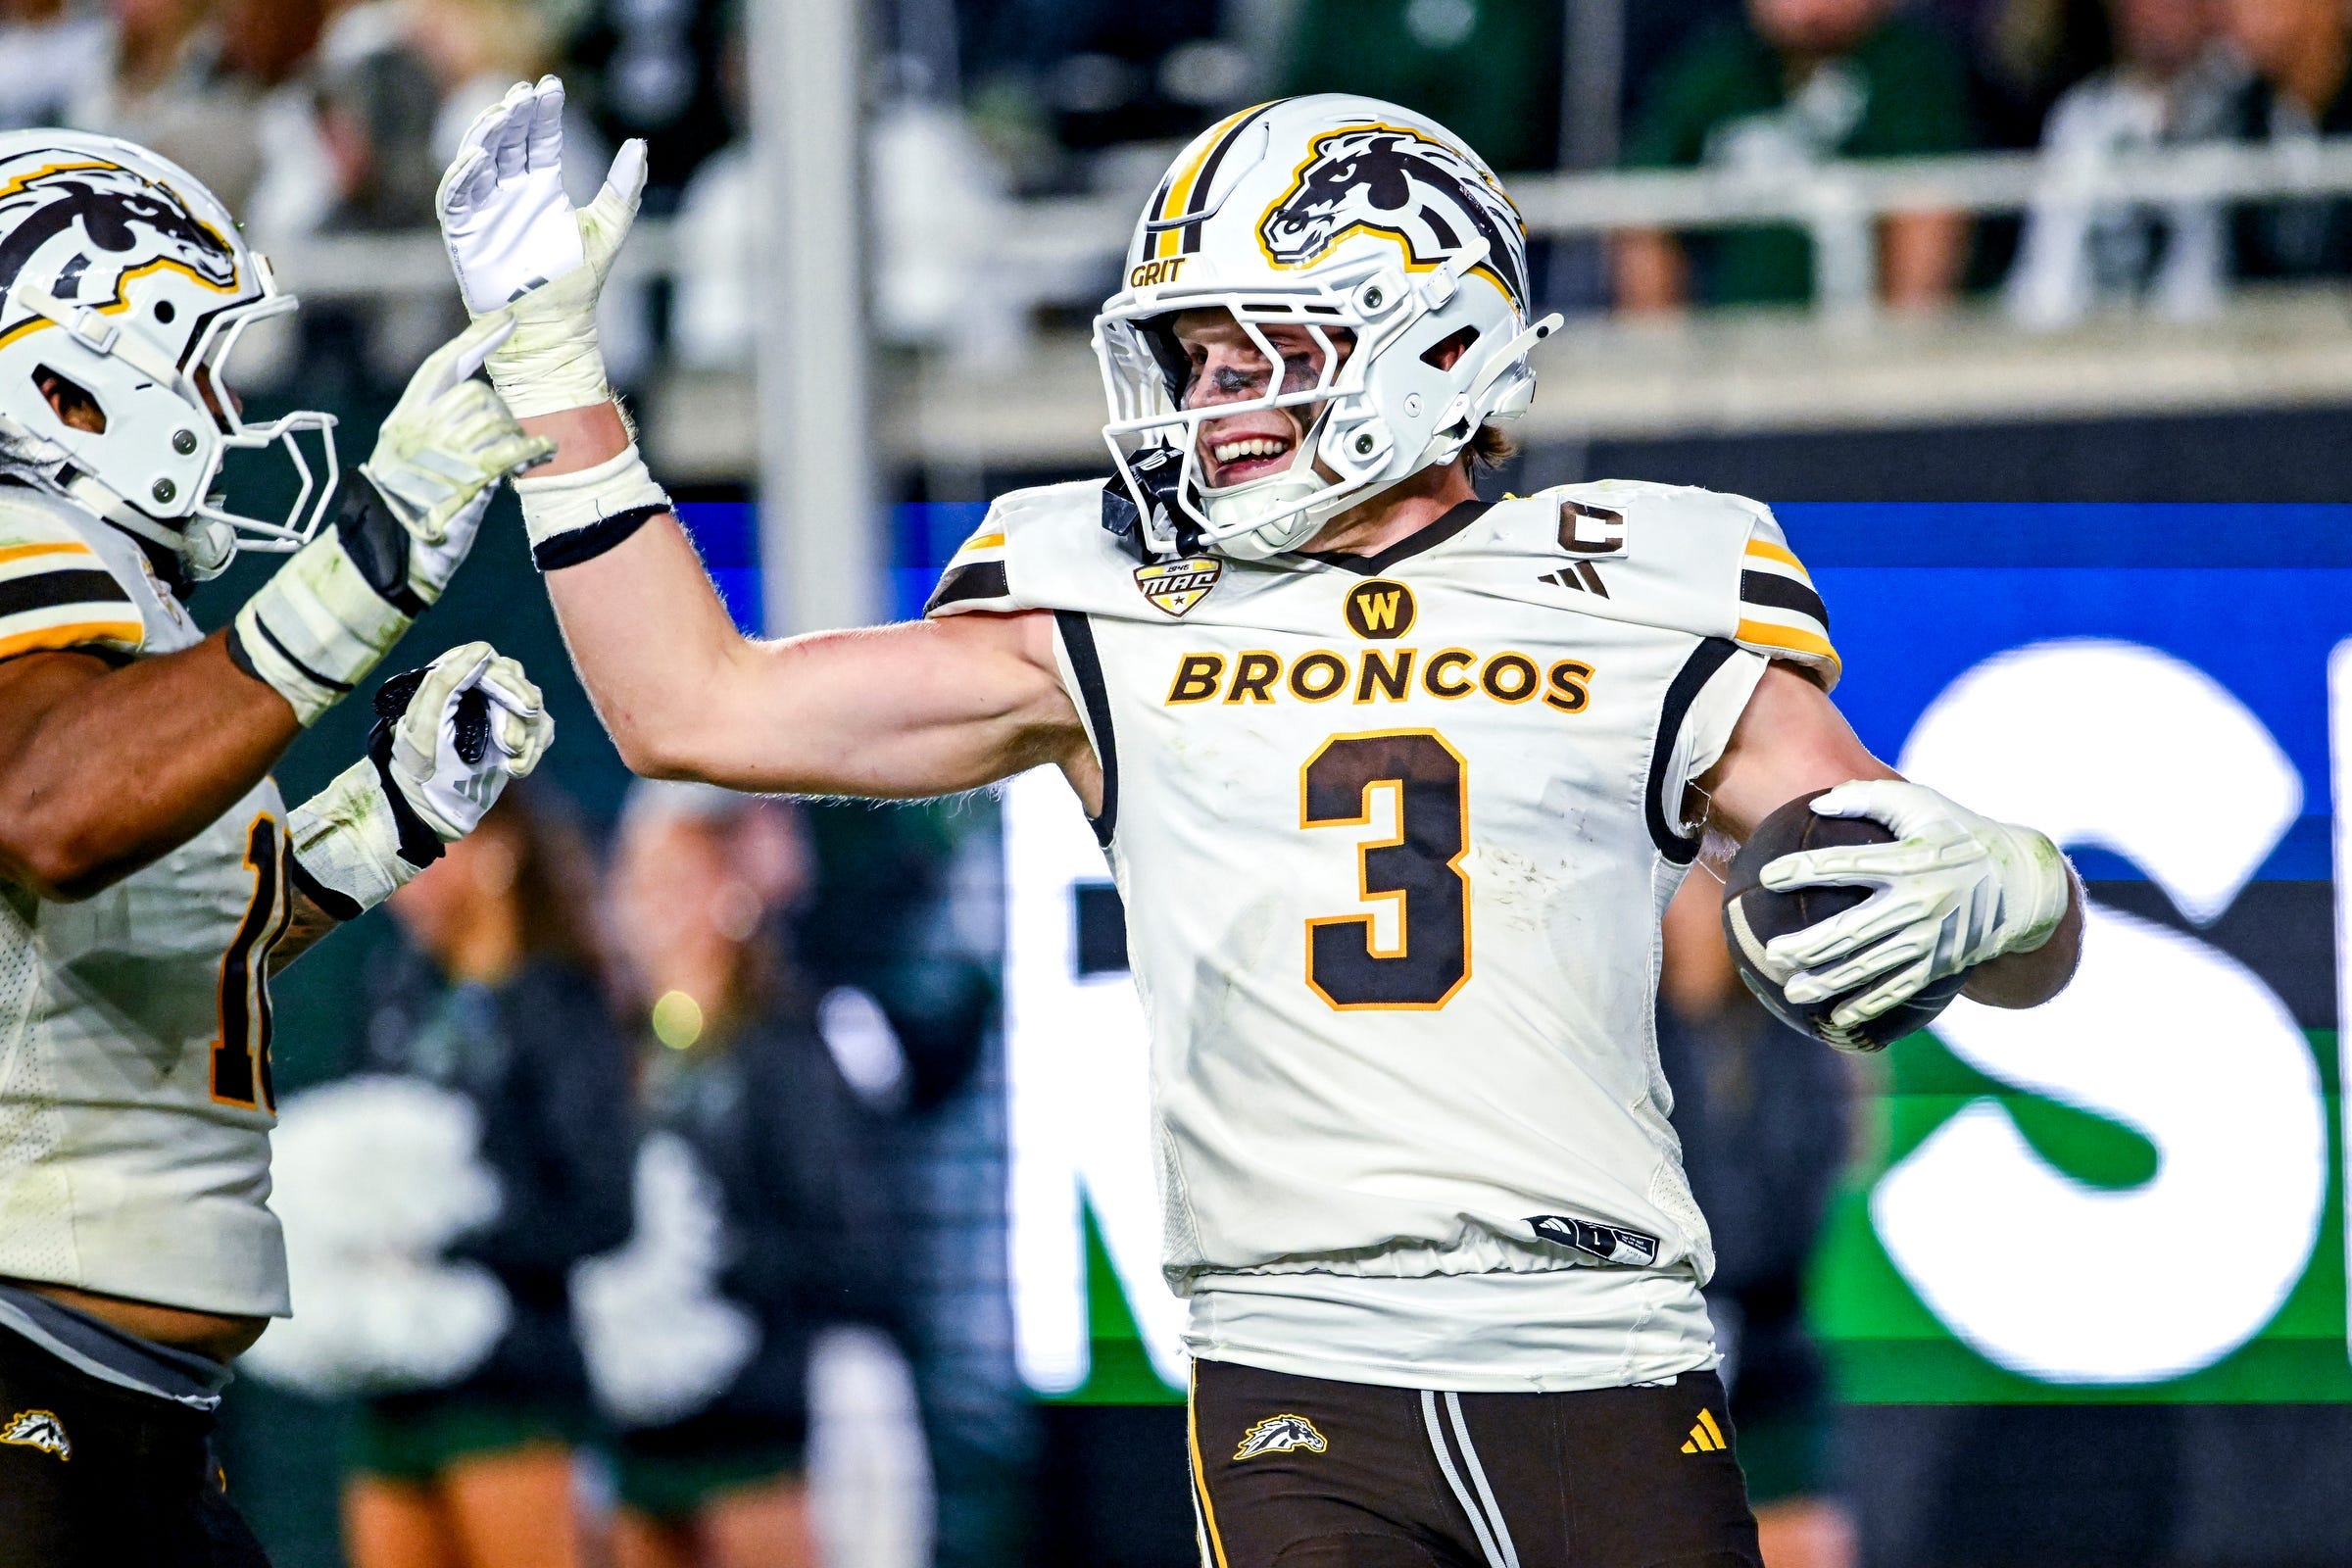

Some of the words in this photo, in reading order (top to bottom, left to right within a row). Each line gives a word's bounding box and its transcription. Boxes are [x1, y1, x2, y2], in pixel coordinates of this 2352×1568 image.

[1130, 257, 1187, 288] GRIT
[1559, 501, 1624, 553] C
[1142, 573, 1216, 595] MAC
[1357, 591, 1400, 630] W
[1164, 647, 1595, 713] BRONCOS
[1299, 727, 1472, 1011] 3
[210, 810, 293, 1118] 1
